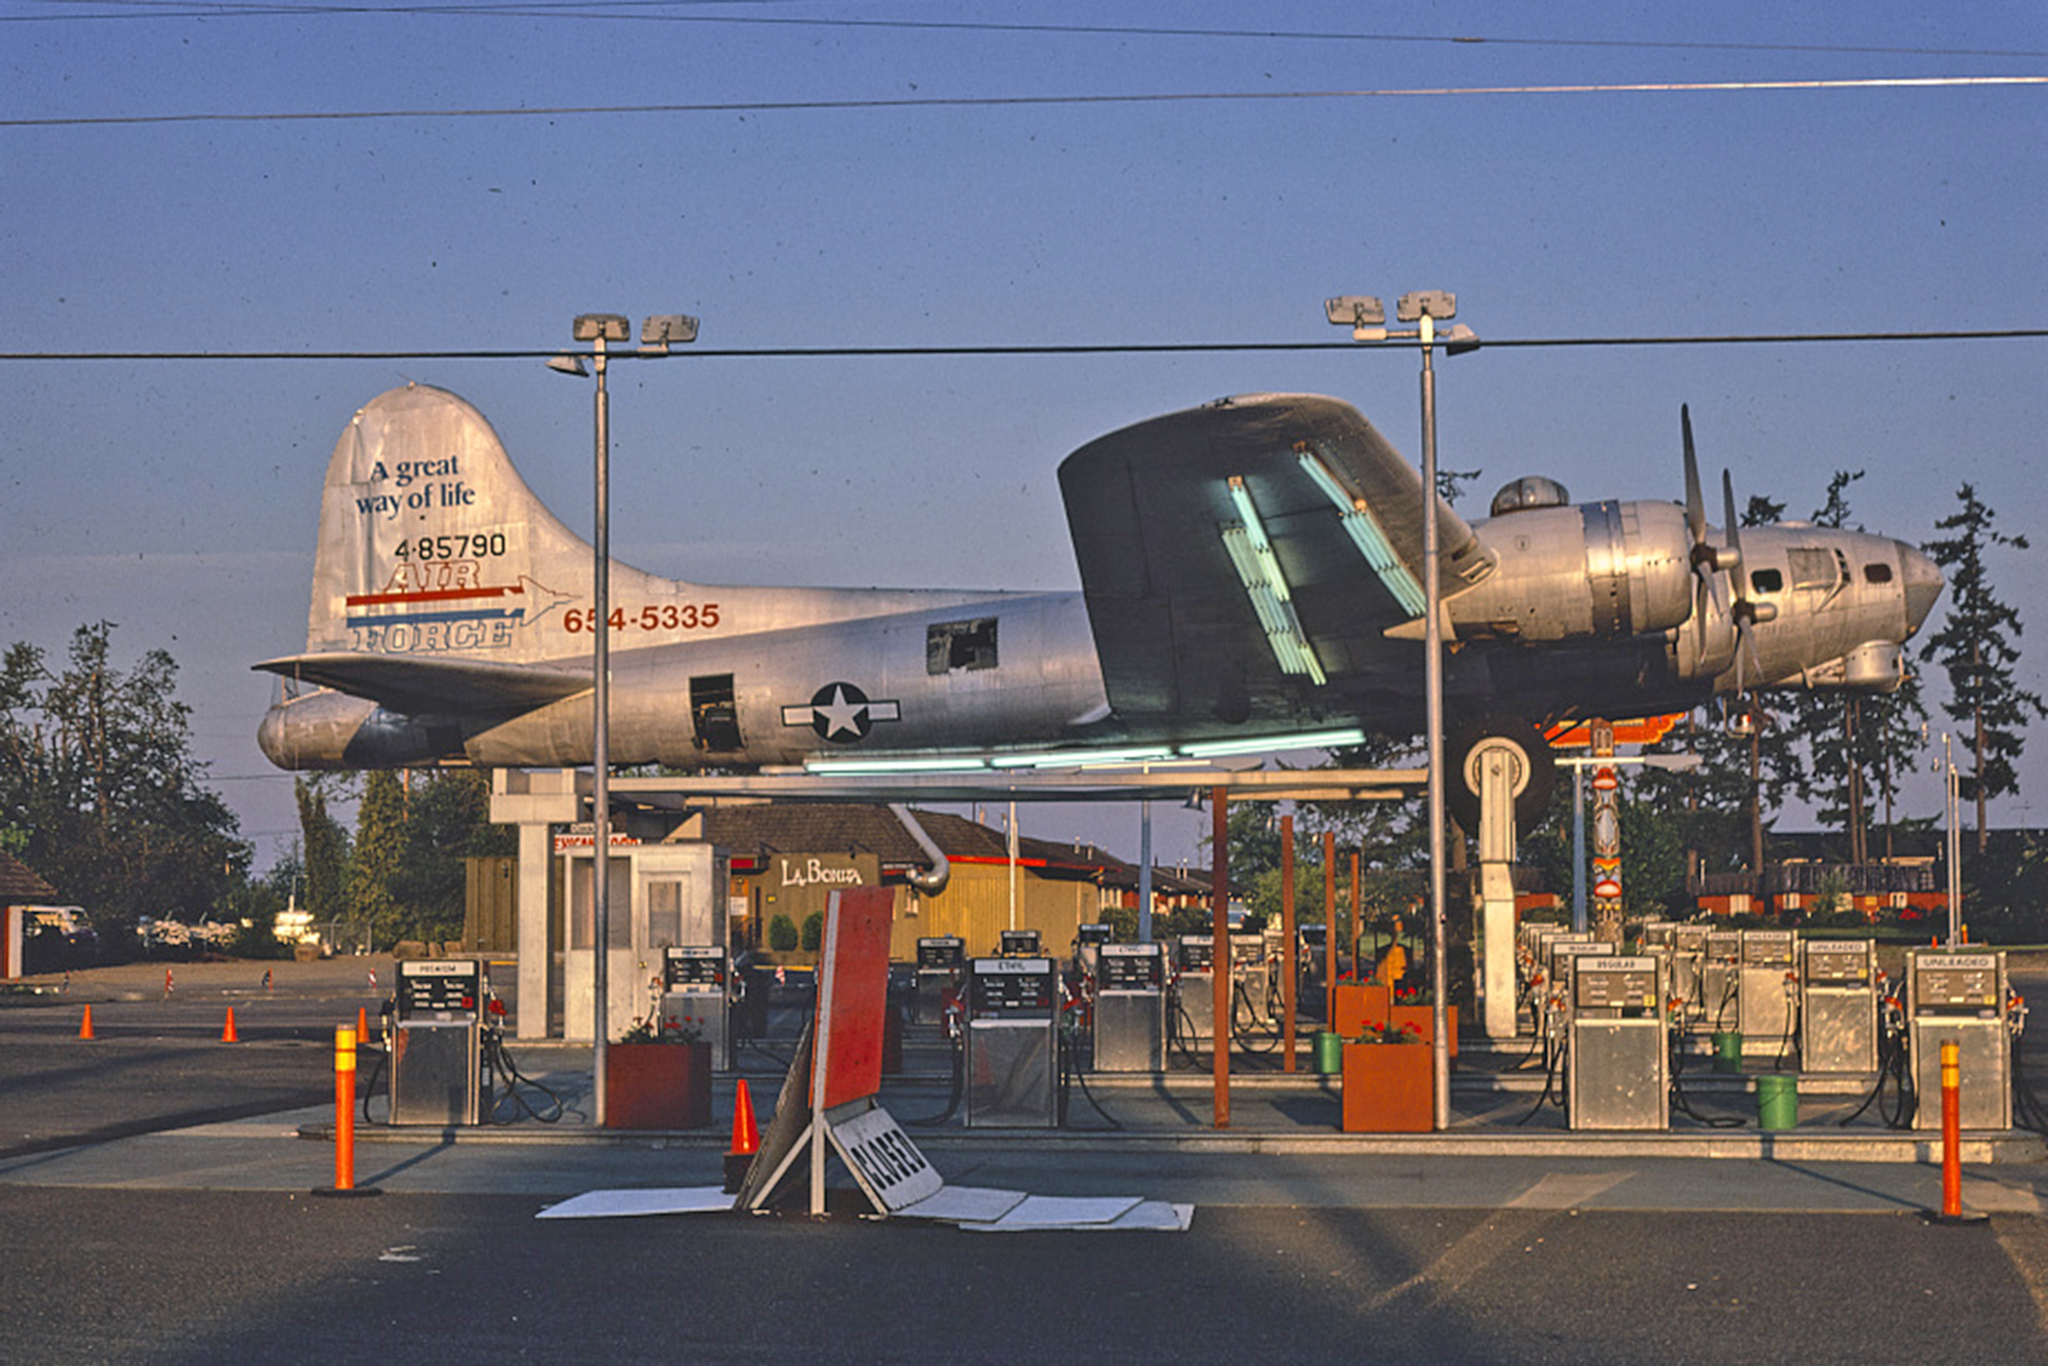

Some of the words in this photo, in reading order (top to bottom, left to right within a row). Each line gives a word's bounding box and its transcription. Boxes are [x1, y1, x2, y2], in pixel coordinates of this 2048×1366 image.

[370, 461, 389, 482] A
[396, 455, 459, 487] great
[355, 494, 402, 521] way
[408, 483, 434, 509] of
[440, 481, 476, 507] life
[383, 559, 481, 592] AIR
[353, 616, 516, 654] FORCE
[1811, 943, 1862, 951] UNLEADED
[1923, 957, 1990, 967] UNLEADED
[850, 1128, 927, 1191] CLOSED
